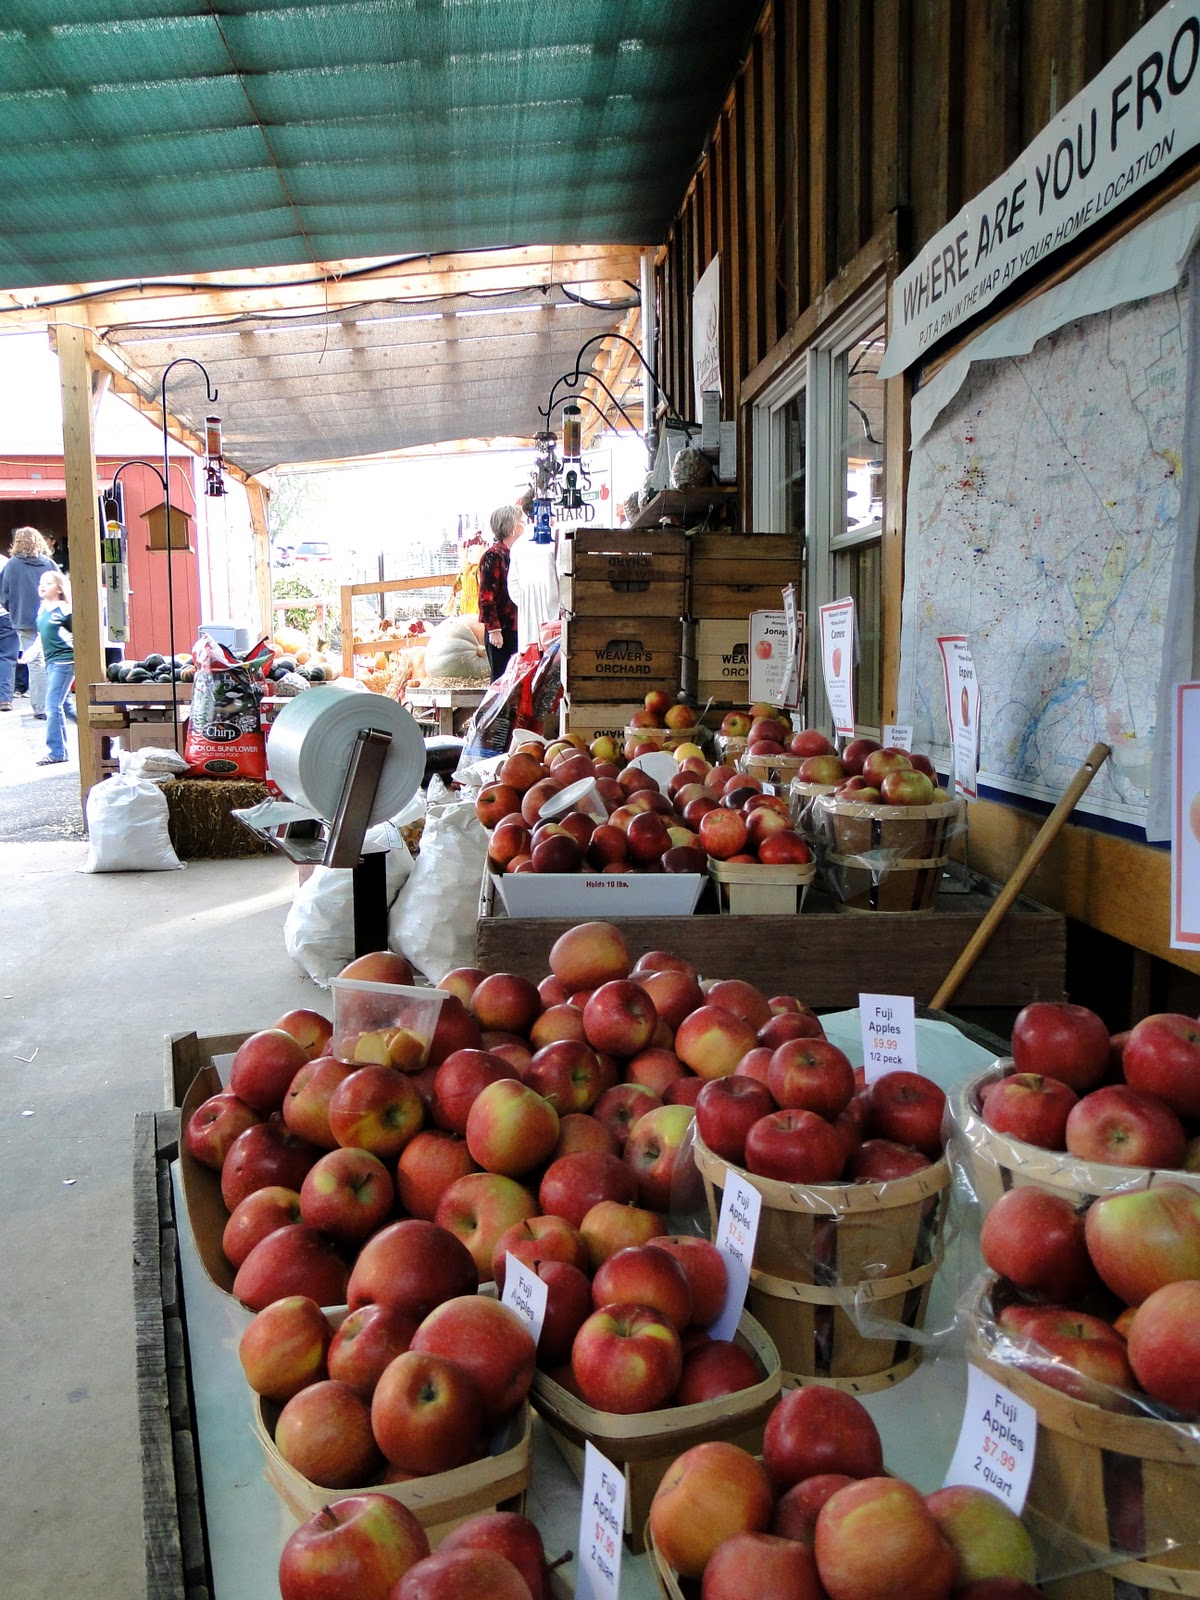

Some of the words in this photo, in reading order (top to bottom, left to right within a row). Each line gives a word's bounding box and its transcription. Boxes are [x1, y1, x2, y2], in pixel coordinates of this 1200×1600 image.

[903, 230, 969, 326] WHERE
[974, 178, 1027, 269] ARE
[1035, 108, 1096, 216] YOU
[1110, 16, 1200, 152] FRO
[918, 323, 933, 347] PUT
[933, 320, 939, 336] A
[940, 309, 954, 331] PIN
[954, 301, 963, 318] IN
[963, 285, 979, 312] THE
[979, 268, 1000, 298] MAP
[1002, 257, 1017, 284] AT
[1020, 232, 1053, 271] YOUR
[1053, 198, 1094, 246] HOME
[1095, 128, 1175, 214] LOCATION
[556, 504, 595, 522] HARD
[764, 628, 788, 637] Jonago
[831, 630, 845, 639] Cameo
[595, 651, 652, 661] WEAVER'S
[595, 664, 651, 674] ORCHARD
[959, 666, 972, 681] Empire
[206, 726, 236, 739] Chirp
[875, 1007, 893, 1021] Fuji
[869, 1021, 901, 1034] Apples
[873, 1038, 897, 1050] $9.99
[870, 1052, 881, 1061] 1/2
[883, 1055, 902, 1064] peck
[736, 1190, 750, 1210] Fuji
[728, 1203, 750, 1230] Apples
[724, 1237, 729, 1248] 2
[729, 1243, 743, 1263] quart
[518, 1276, 533, 1298] Fuji
[511, 1288, 535, 1320] Apples
[994, 1394, 1016, 1423] Fuji
[982, 1410, 1024, 1451] Apples
[982, 1436, 1015, 1472] $7.99
[974, 1456, 981, 1471] 2
[983, 1468, 1012, 1496] quart
[601, 1472, 617, 1503] Fuji
[592, 1492, 619, 1535] Apples
[591, 1545, 597, 1560] 2
[597, 1555, 614, 1586] quart
